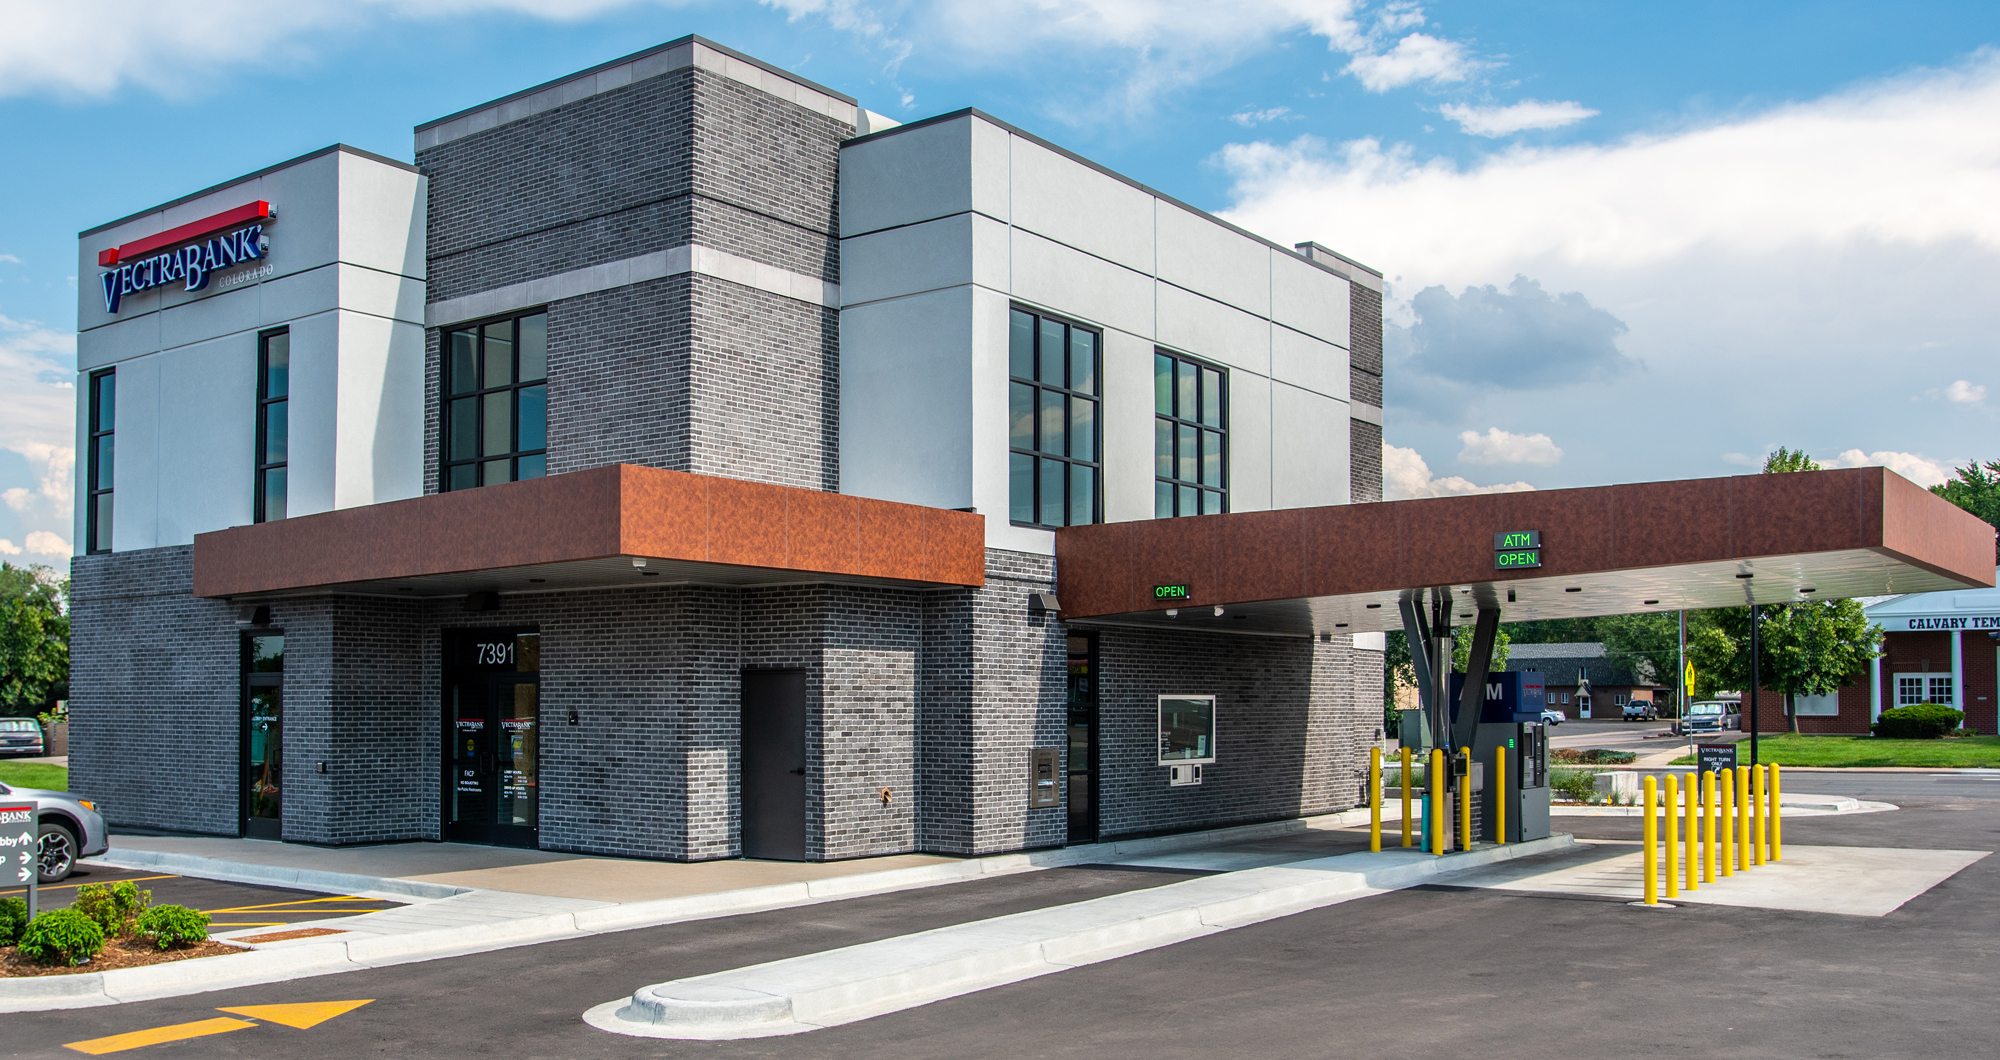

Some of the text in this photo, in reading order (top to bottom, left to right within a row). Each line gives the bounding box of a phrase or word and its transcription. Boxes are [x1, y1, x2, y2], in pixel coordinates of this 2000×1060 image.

[219, 264, 273, 288] COLORADO
[1503, 533, 1531, 547] ATM
[1499, 552, 1536, 566] OPEN
[1155, 585, 1185, 598] OPEN
[1908, 617, 1968, 630] CALVARY
[477, 642, 514, 665] 7391
[0, 811, 31, 823] BANK
